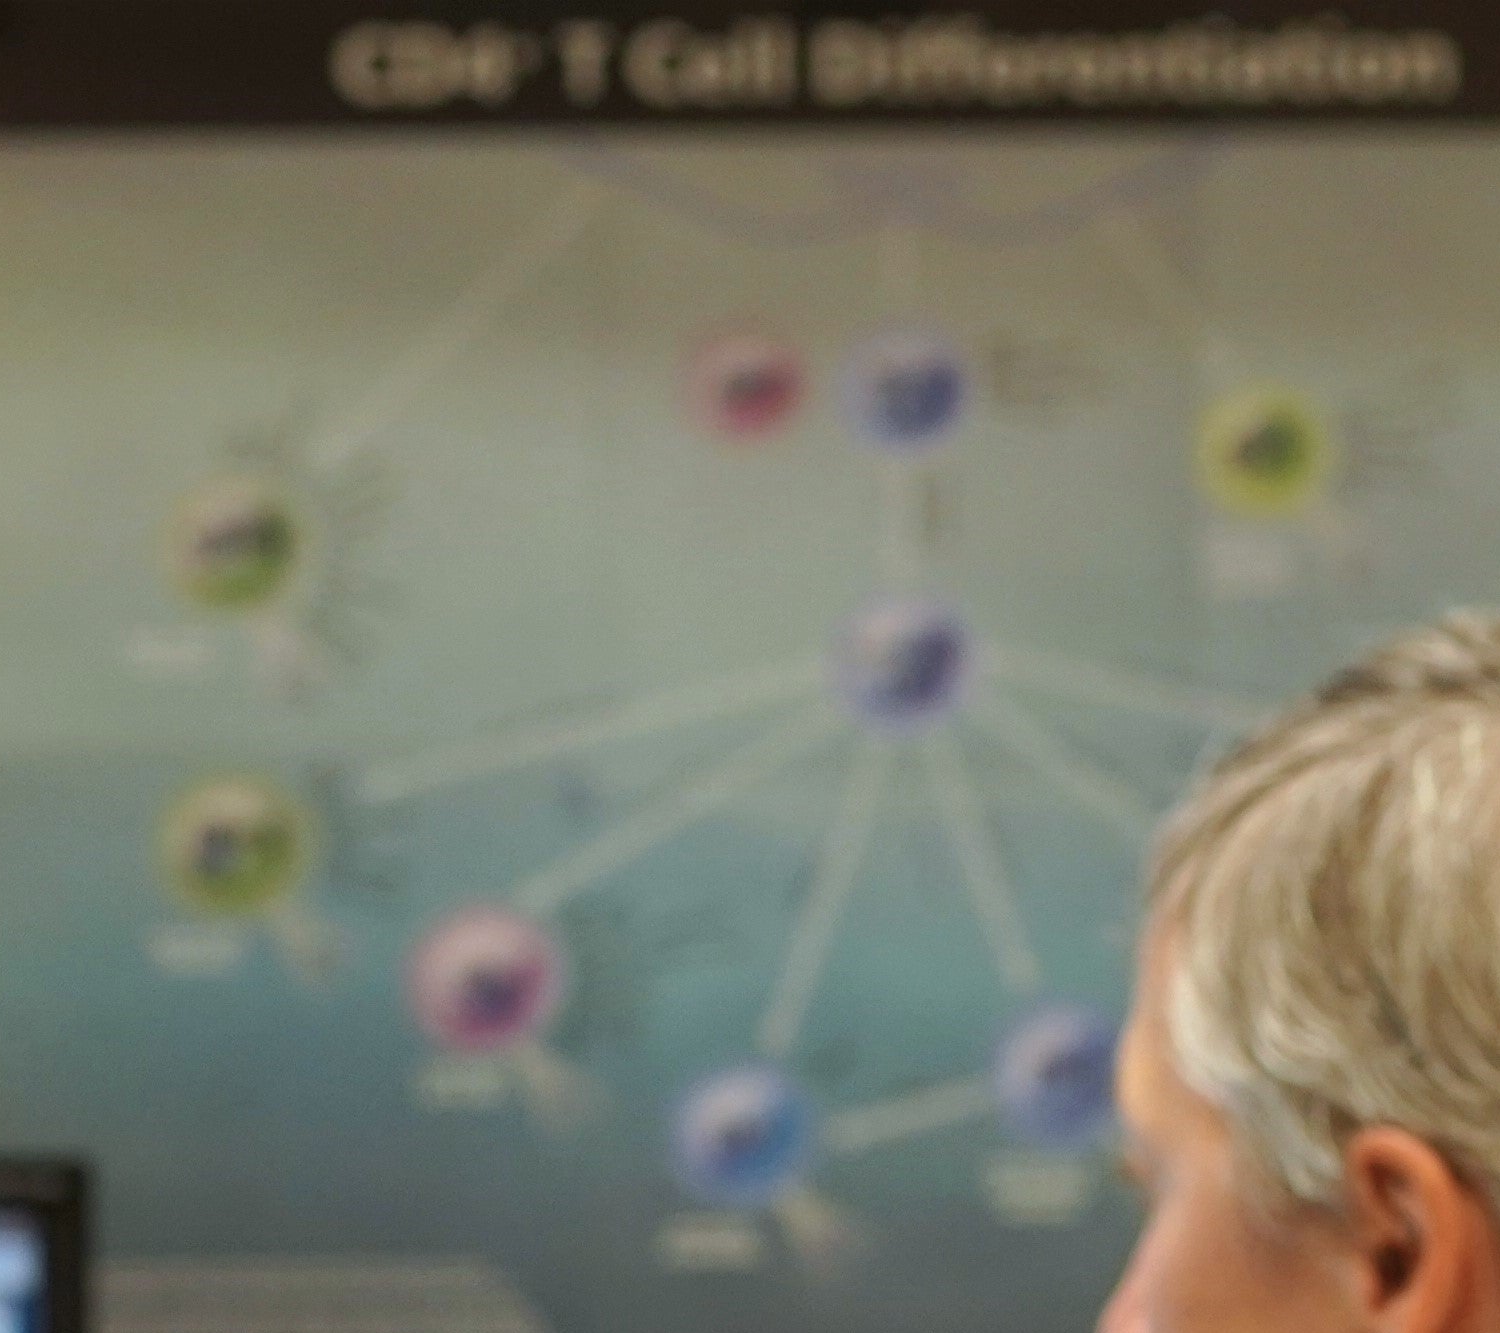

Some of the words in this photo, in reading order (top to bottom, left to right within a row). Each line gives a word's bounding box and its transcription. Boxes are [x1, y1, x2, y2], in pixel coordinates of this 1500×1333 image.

[555, 18, 612, 108] T
[622, 14, 798, 108] Cell
[808, 12, 1464, 108] Differentiation
